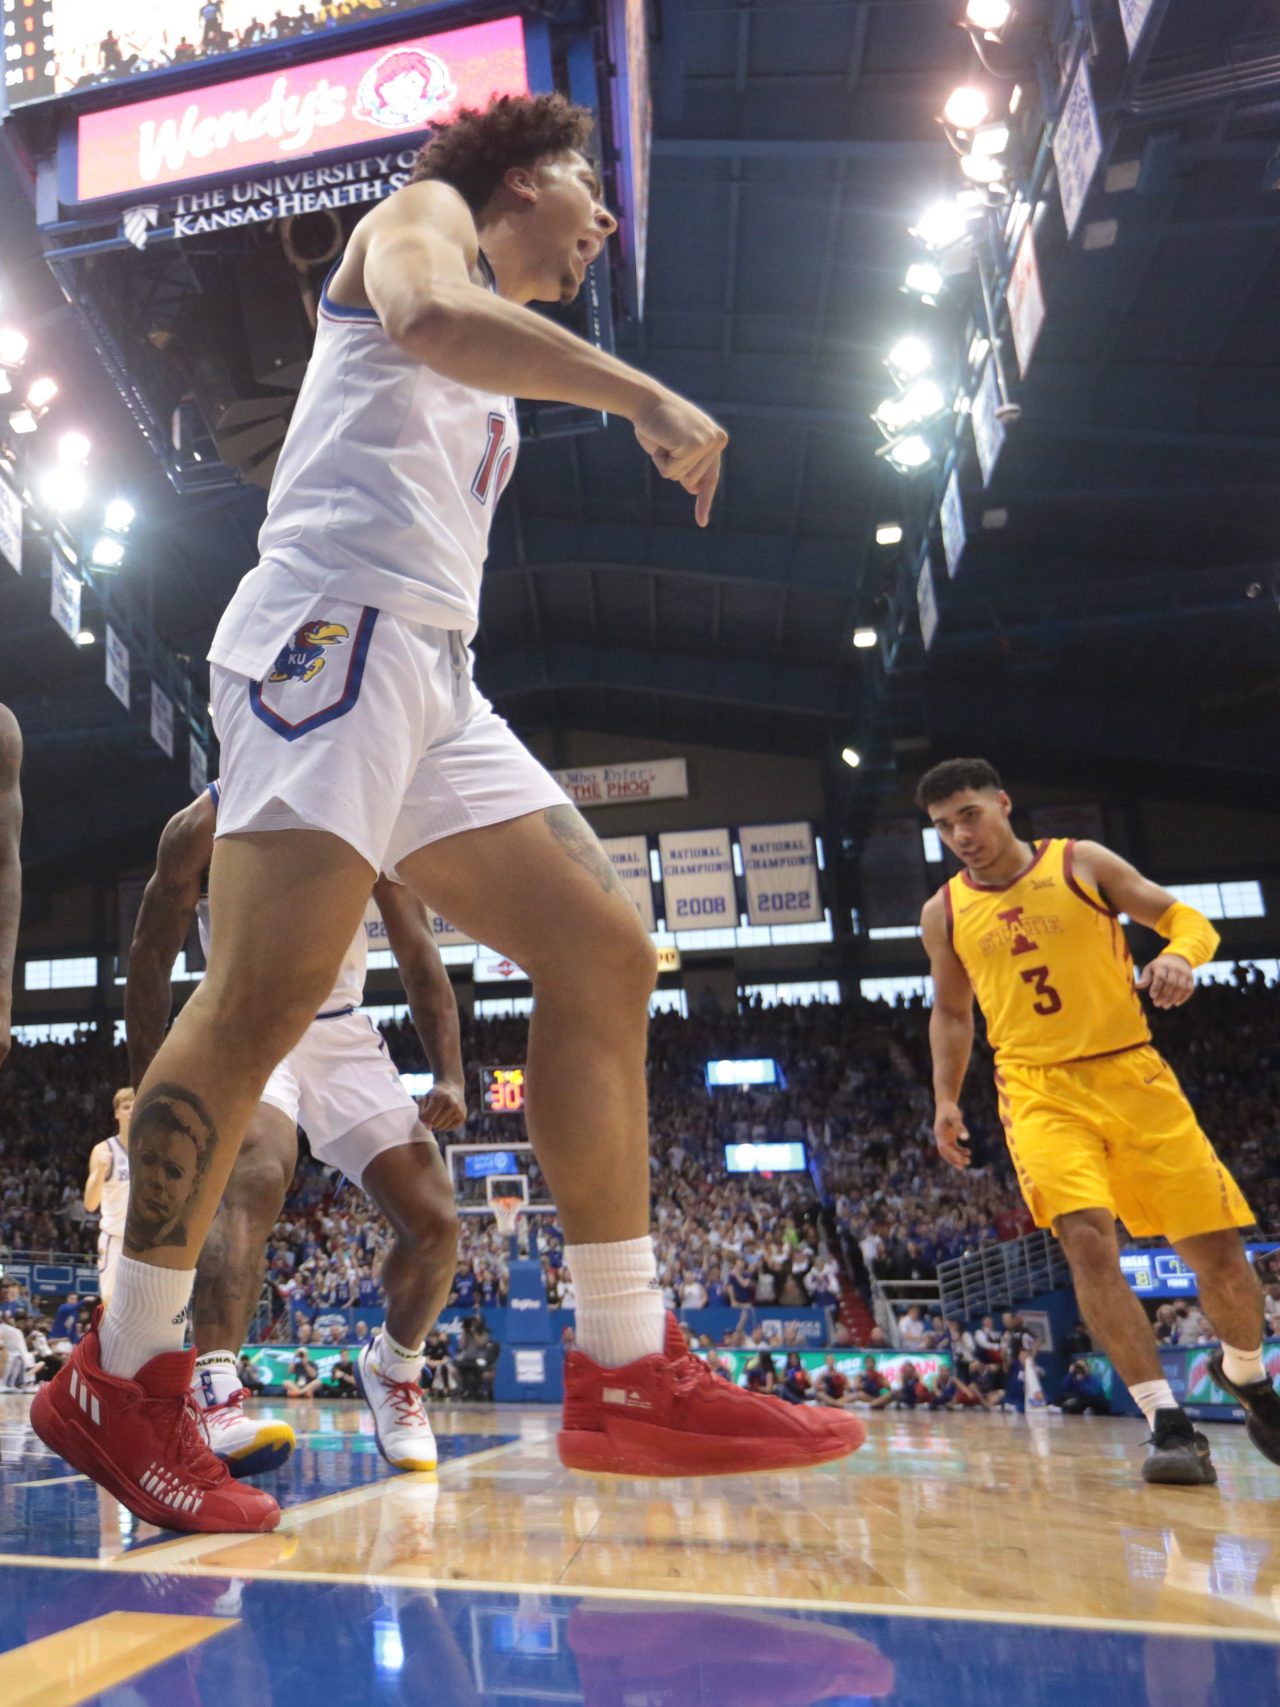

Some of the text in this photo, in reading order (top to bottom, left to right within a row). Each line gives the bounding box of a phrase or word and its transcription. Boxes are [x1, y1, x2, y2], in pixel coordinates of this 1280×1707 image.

[139, 77, 347, 181] Wendy's
[173, 149, 419, 215] THE UNIVERSITY O
[171, 200, 273, 238] KANSAS
[278, 179, 382, 219] HEALTH
[288, 653, 306, 665] KU
[669, 847, 722, 860] NATIONAL
[750, 840, 805, 854] NATIONAL
[664, 862, 731, 877] CHAMPIONS
[745, 855, 815, 872] CHAMPIONS
[676, 897, 726, 917] 2008
[757, 892, 811, 912] 2022
[978, 914, 1064, 957] STATE
[1020, 965, 1062, 1016] 3
